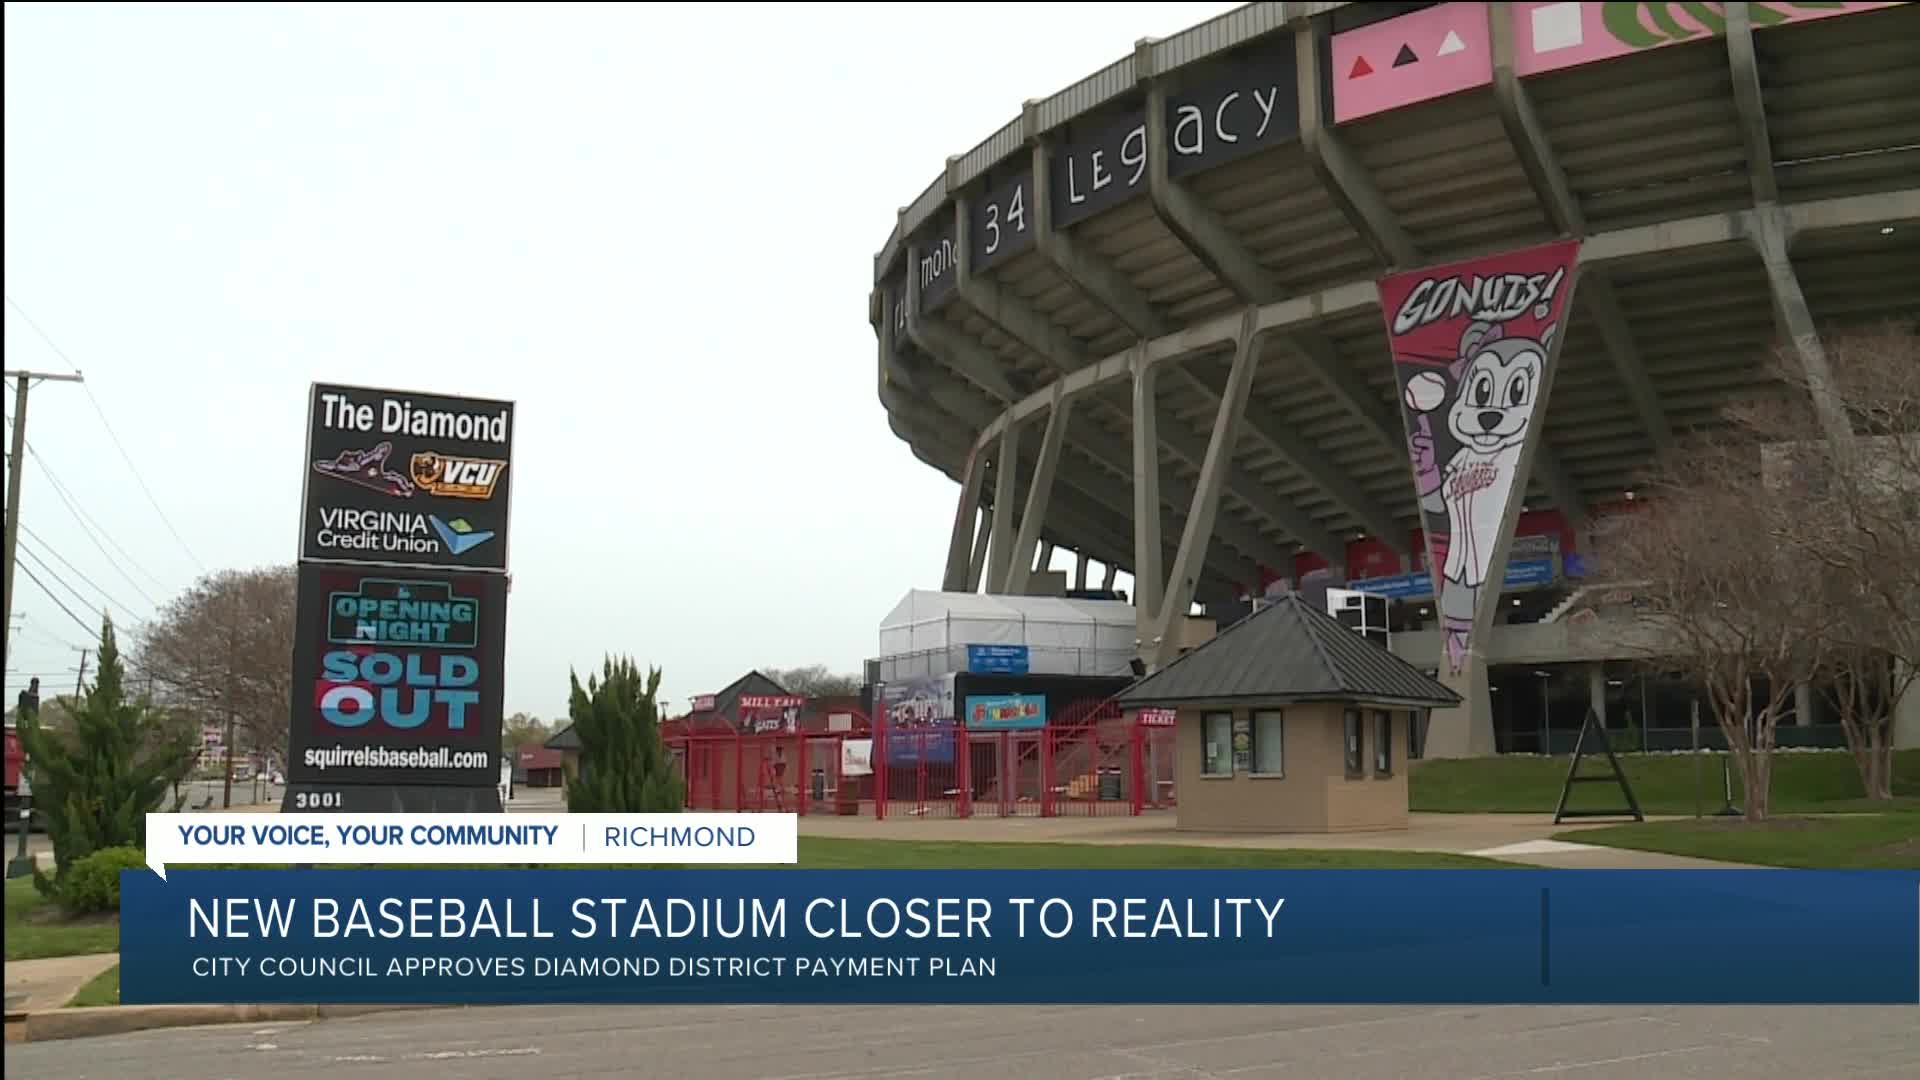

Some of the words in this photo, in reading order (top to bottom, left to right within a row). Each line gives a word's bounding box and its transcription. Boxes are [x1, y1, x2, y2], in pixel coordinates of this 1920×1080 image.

[984, 183, 1026, 255] 34
[321, 394, 375, 431] The
[382, 399, 508, 443] Diamond
[443, 461, 498, 486] VCU
[319, 507, 429, 535] VIRGINIA
[317, 530, 379, 550] Credit
[382, 534, 440, 553] Union
[335, 597, 473, 622] OPENING
[355, 619, 451, 642] NIGHT
[321, 650, 480, 687] SOLD
[320, 684, 481, 730] OUT
[304, 744, 488, 770] squirrelsbaseball.com
[296, 792, 343, 809] 3001
